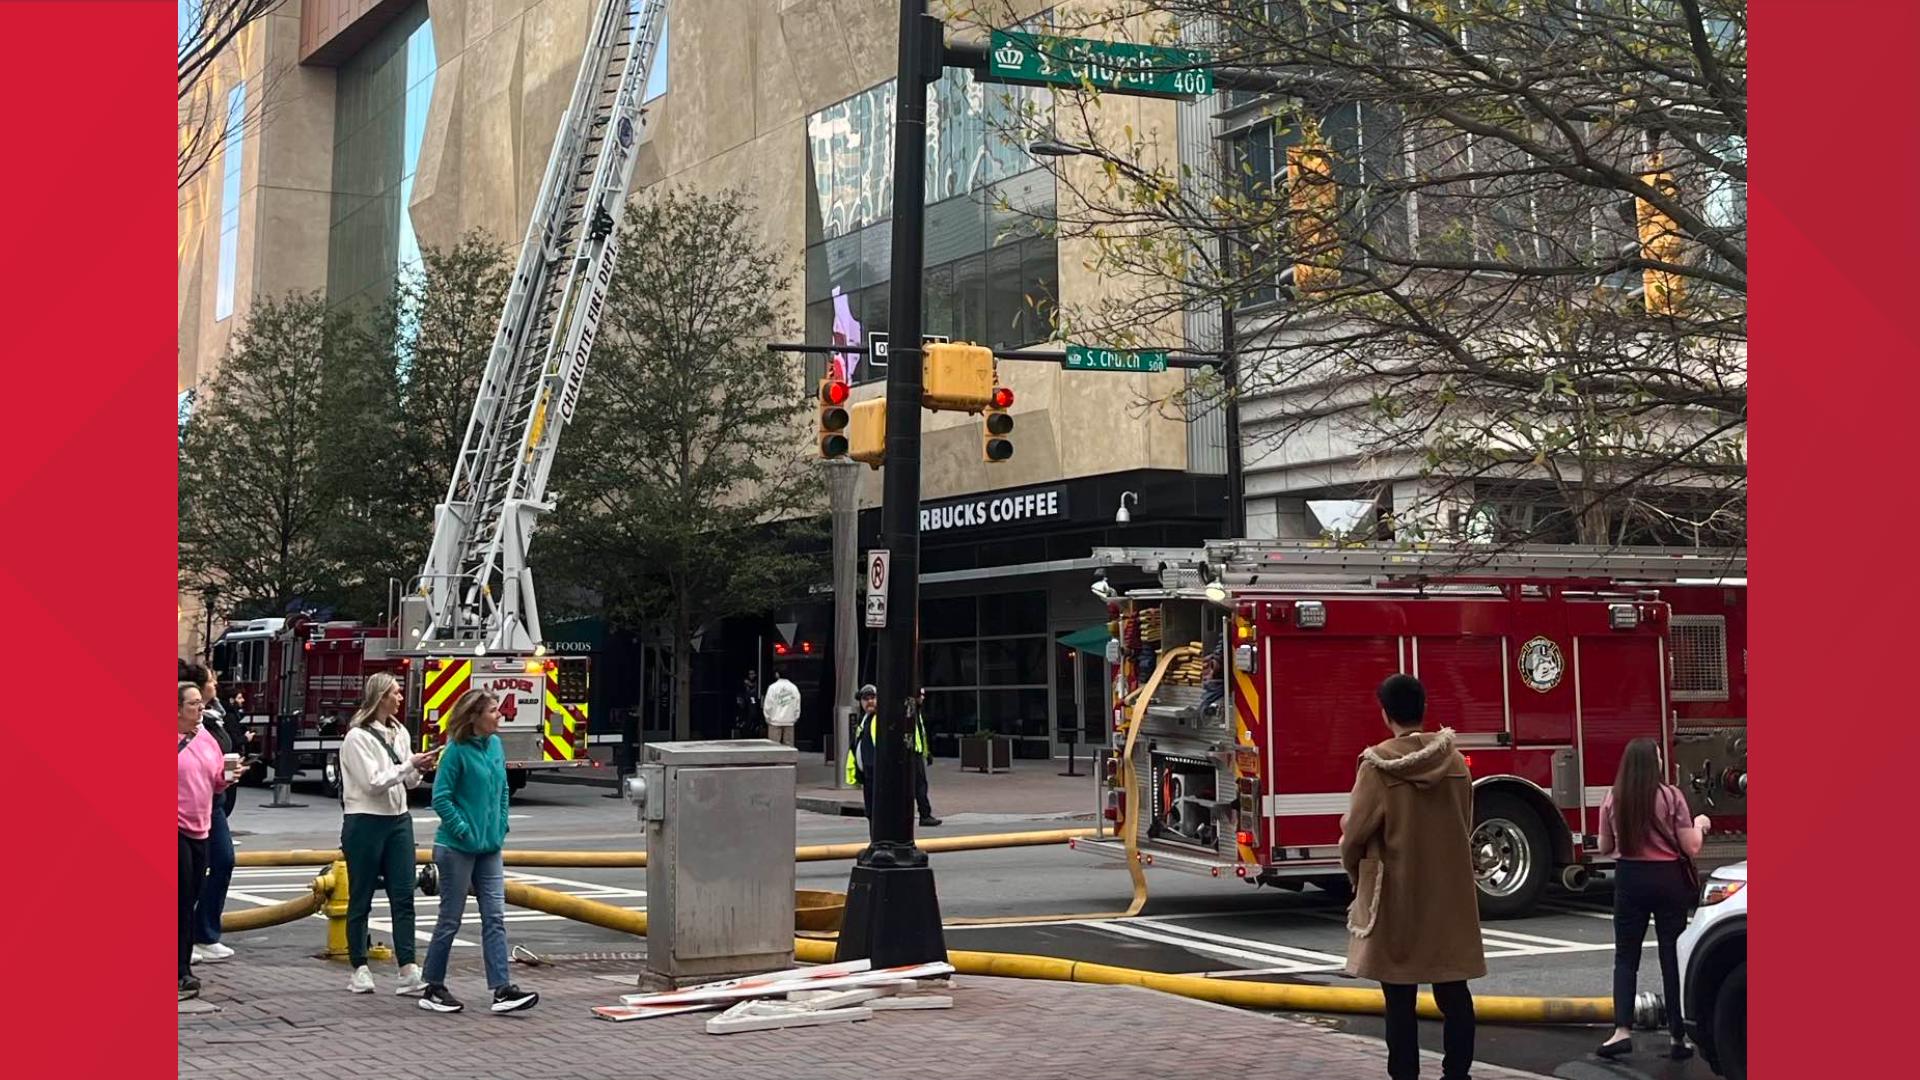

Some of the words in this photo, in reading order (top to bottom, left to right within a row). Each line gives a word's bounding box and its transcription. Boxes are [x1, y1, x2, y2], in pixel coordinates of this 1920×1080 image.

[1069, 46, 1153, 84] Church
[1173, 73, 1206, 94] 400
[561, 325, 593, 419] CHARLOTTE
[587, 287, 604, 325] FIRE
[598, 242, 618, 286] DEPT.
[1086, 350, 1097, 367] S.
[1148, 361, 1164, 372] 500
[920, 501, 987, 531] RBUCKS
[990, 491, 1058, 523] COFFEE
[556, 641, 592, 652] FOODS
[498, 693, 518, 722] 4
